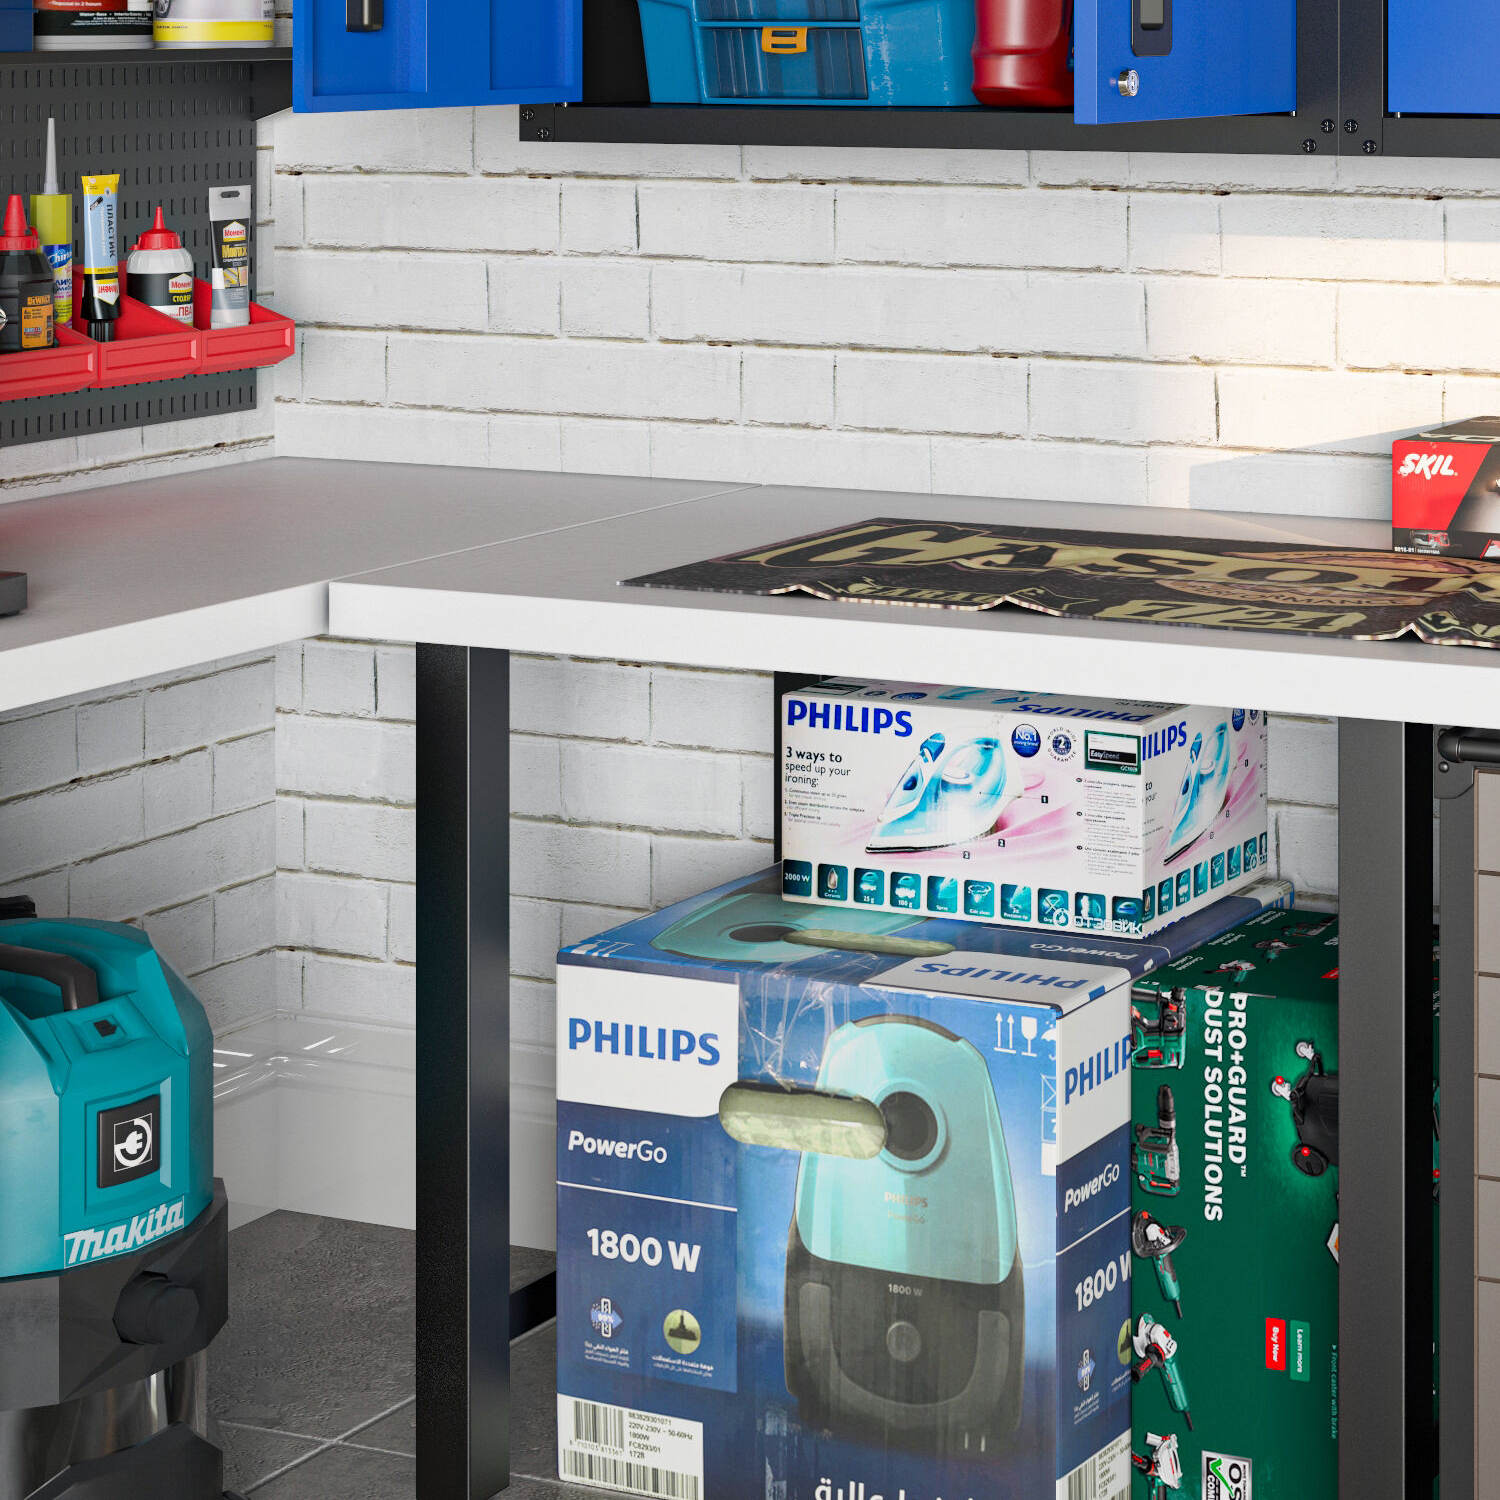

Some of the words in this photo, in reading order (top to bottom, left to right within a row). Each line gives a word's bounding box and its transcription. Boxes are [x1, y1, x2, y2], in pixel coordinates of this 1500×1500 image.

[107, 204, 116, 258] ПЛАСТИК
[224, 229, 245, 237] Момент
[1400, 453, 1456, 478] SKIL
[1179, 585, 1414, 606] PERFORMANCE
[1136, 602, 1343, 629] 7/24
[788, 700, 913, 737] PHILIPS
[1011, 702, 1155, 723] PHILIPS
[1015, 731, 1037, 741] No.1
[1047, 726, 1063, 741] WORLD
[1058, 737, 1066, 749] 2
[786, 747, 792, 757] 3
[796, 750, 825, 763] ways
[830, 752, 842, 762] to
[1090, 750, 1120, 760] EasySpeed
[785, 762, 811, 773] speed
[814, 766, 826, 775] up
[829, 768, 851, 777] your
[785, 773, 818, 788] ironing:
[785, 873, 800, 881] 2000
[1073, 916, 1142, 934] ОТЗОВИК
[914, 962, 1089, 991] PHILIPS
[1204, 992, 1224, 1063] DUST
[568, 1017, 721, 1067] PHILIPS
[1064, 1032, 1131, 1105] PHILIP
[568, 1129, 668, 1164] PowerGo
[1204, 1066, 1223, 1221] SOLUTIONS
[1064, 1163, 1120, 1213] PowerGo
[585, 1227, 663, 1268] 1800
[667, 1240, 702, 1274] W
[1075, 1259, 1118, 1312] 1800
[1270, 1327, 1279, 1343] Buy
[629, 1432, 650, 1442] 1800W
